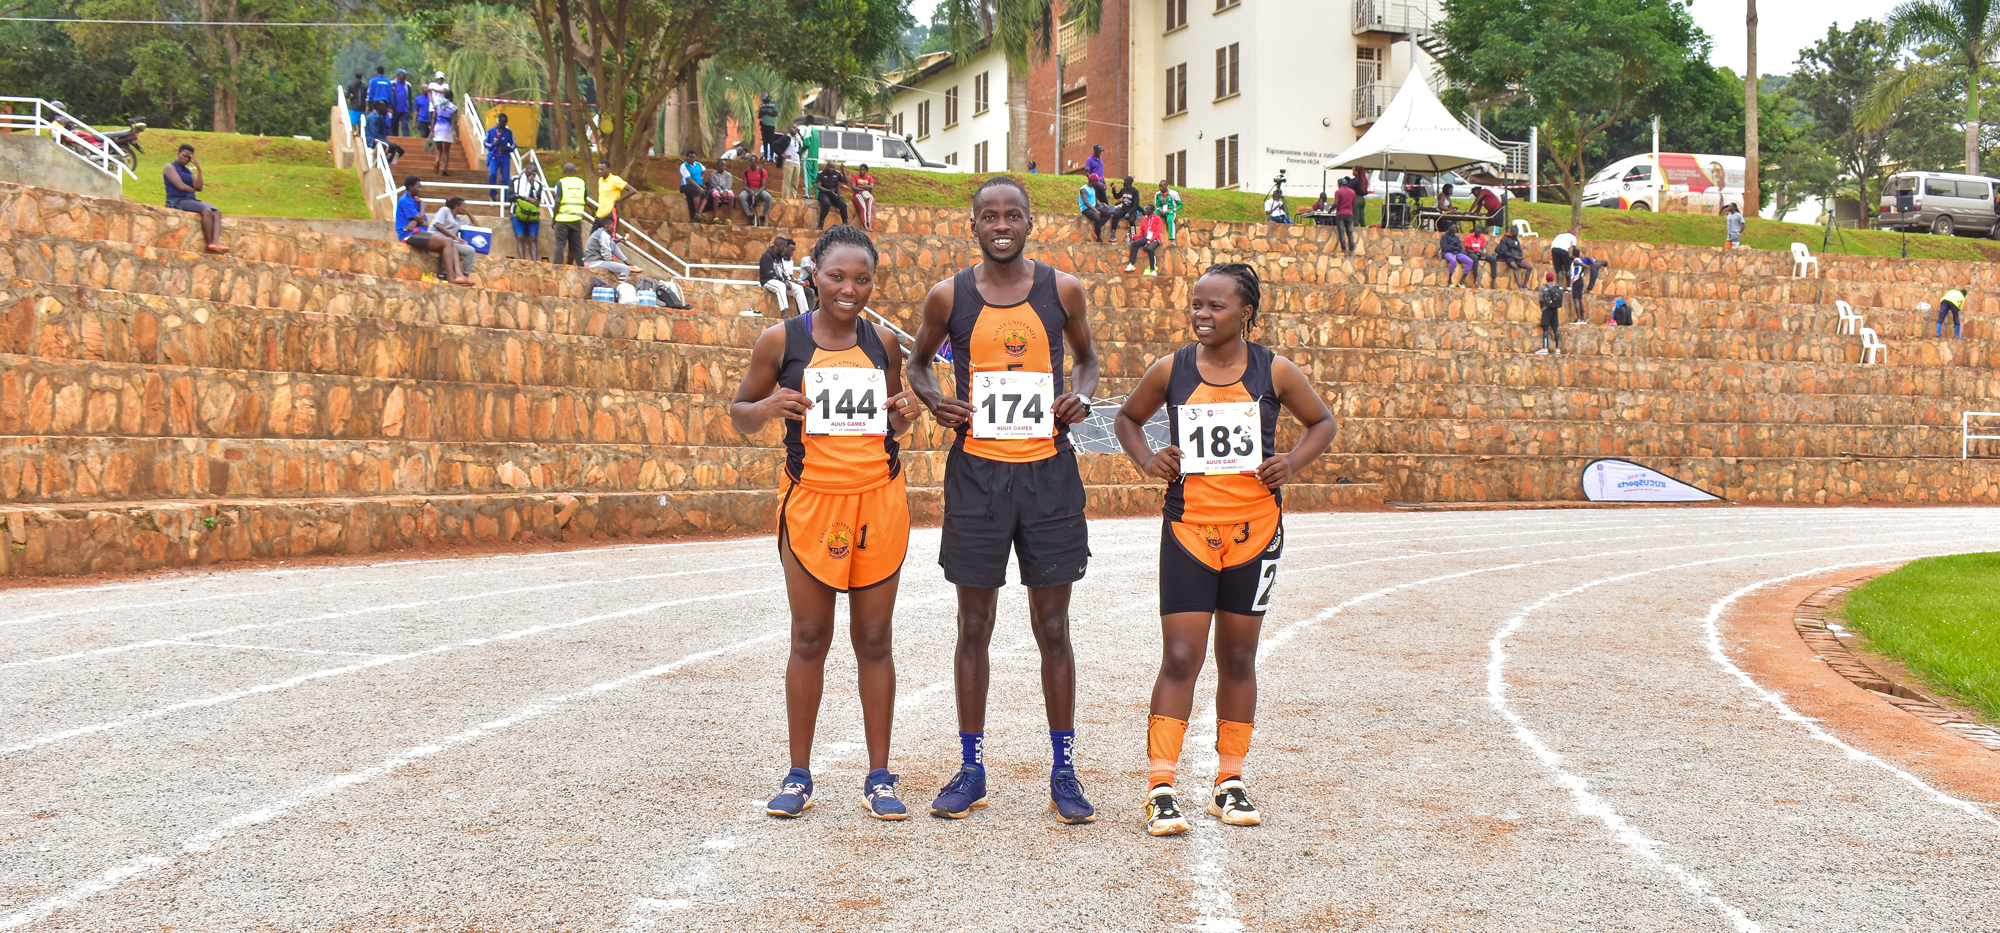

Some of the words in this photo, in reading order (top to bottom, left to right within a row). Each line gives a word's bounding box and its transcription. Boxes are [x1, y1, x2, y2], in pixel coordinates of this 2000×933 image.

[1266, 146, 1301, 156] Righteousness
[1008, 320, 1036, 339] UNIVERSITY
[816, 389, 877, 419] 144
[982, 394, 1044, 423] 174
[1190, 425, 1254, 458] 183
[856, 524, 867, 550] 1
[1233, 522, 1249, 544] 3
[1257, 564, 1276, 605] 2
